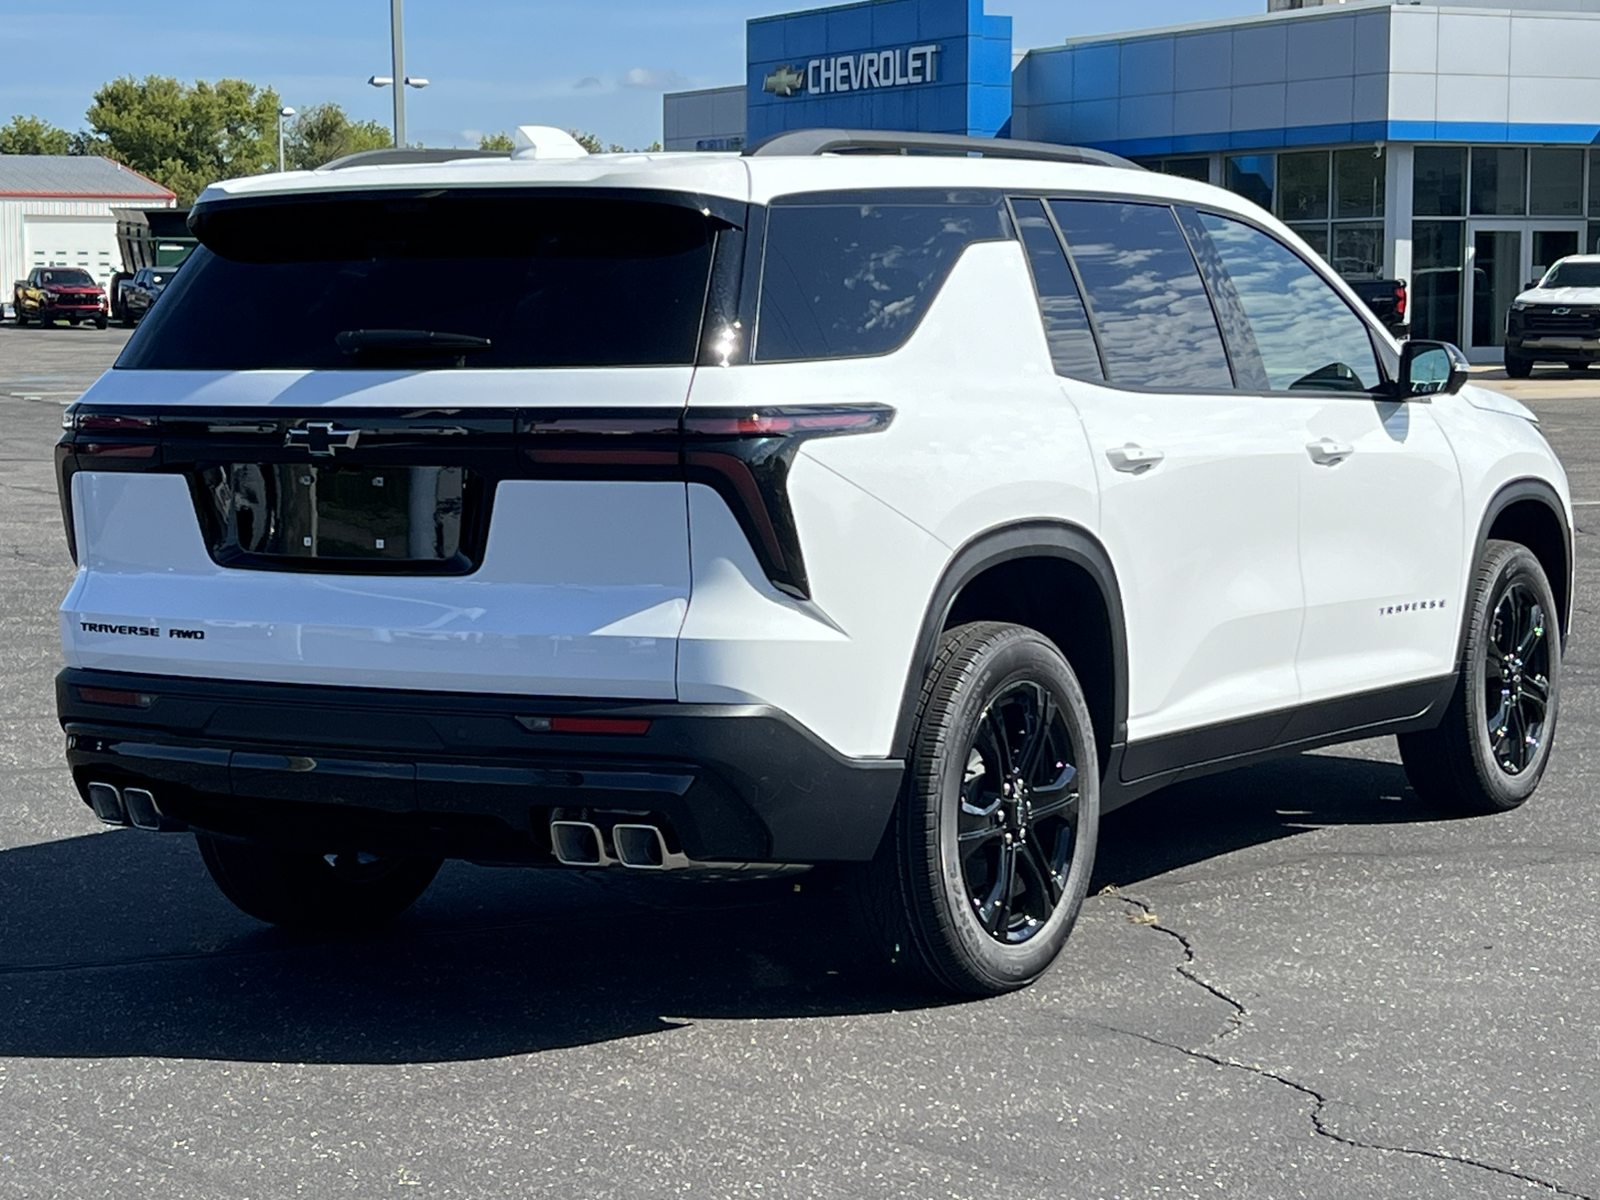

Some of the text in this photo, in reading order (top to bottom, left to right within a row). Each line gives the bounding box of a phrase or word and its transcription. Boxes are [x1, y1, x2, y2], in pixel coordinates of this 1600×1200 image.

[807, 45, 938, 94] CHEVROLET
[1378, 598, 1446, 616] TRAVERSE
[80, 622, 205, 640] TRAVERSE AWD
